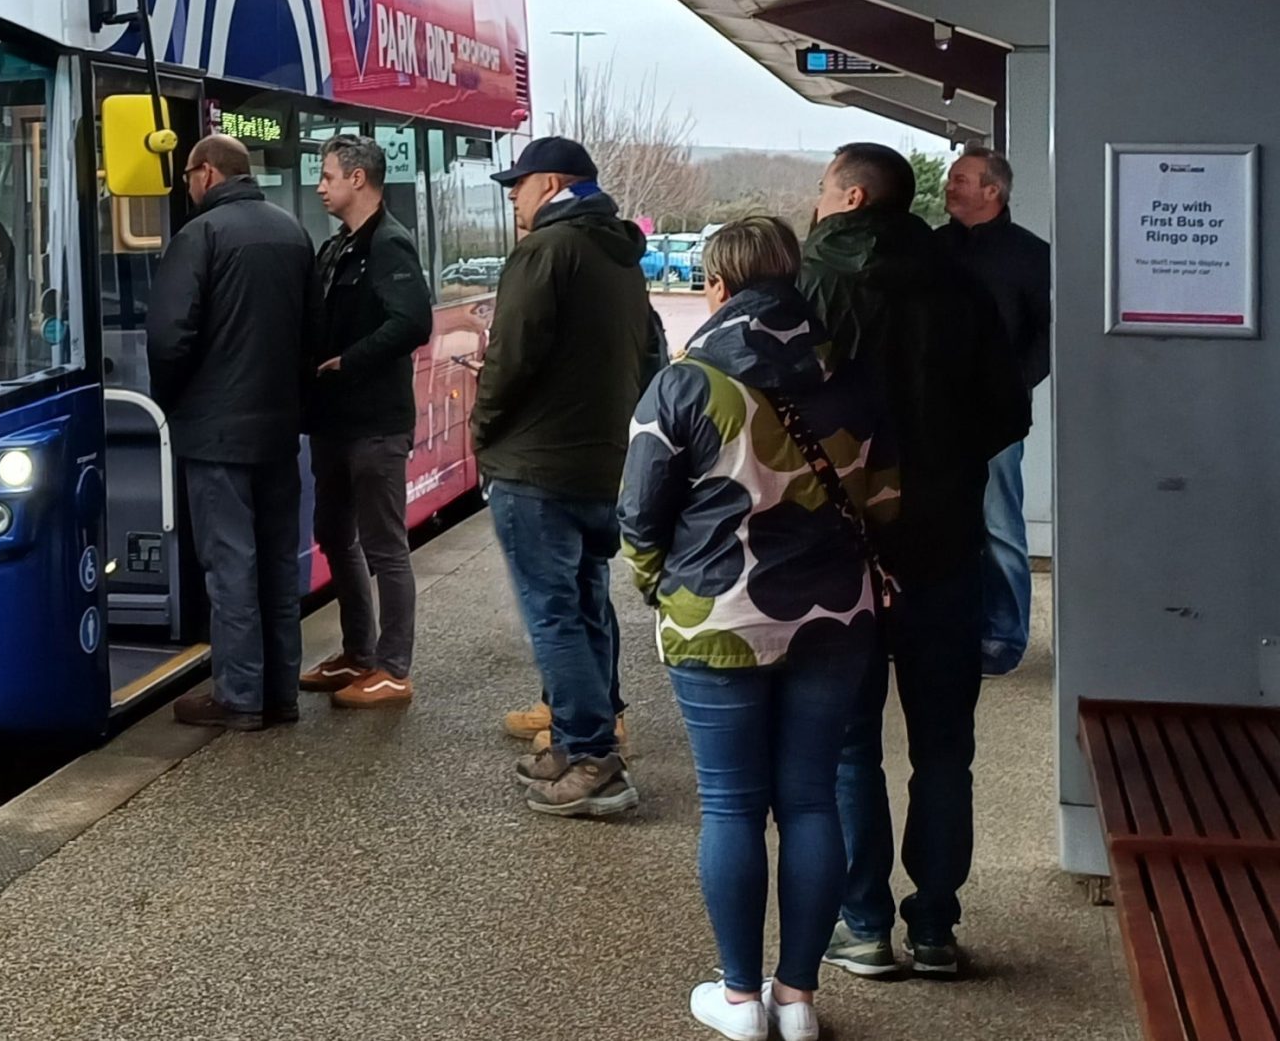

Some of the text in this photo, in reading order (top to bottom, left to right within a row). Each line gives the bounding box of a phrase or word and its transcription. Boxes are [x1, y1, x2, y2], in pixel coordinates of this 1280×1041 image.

[376, 2, 419, 77] PARK
[425, 21, 457, 86] RIDE
[1152, 200, 1212, 214] Pay with
[1141, 215, 1224, 228] First Bus or
[1146, 230, 1218, 245] Ringo app
